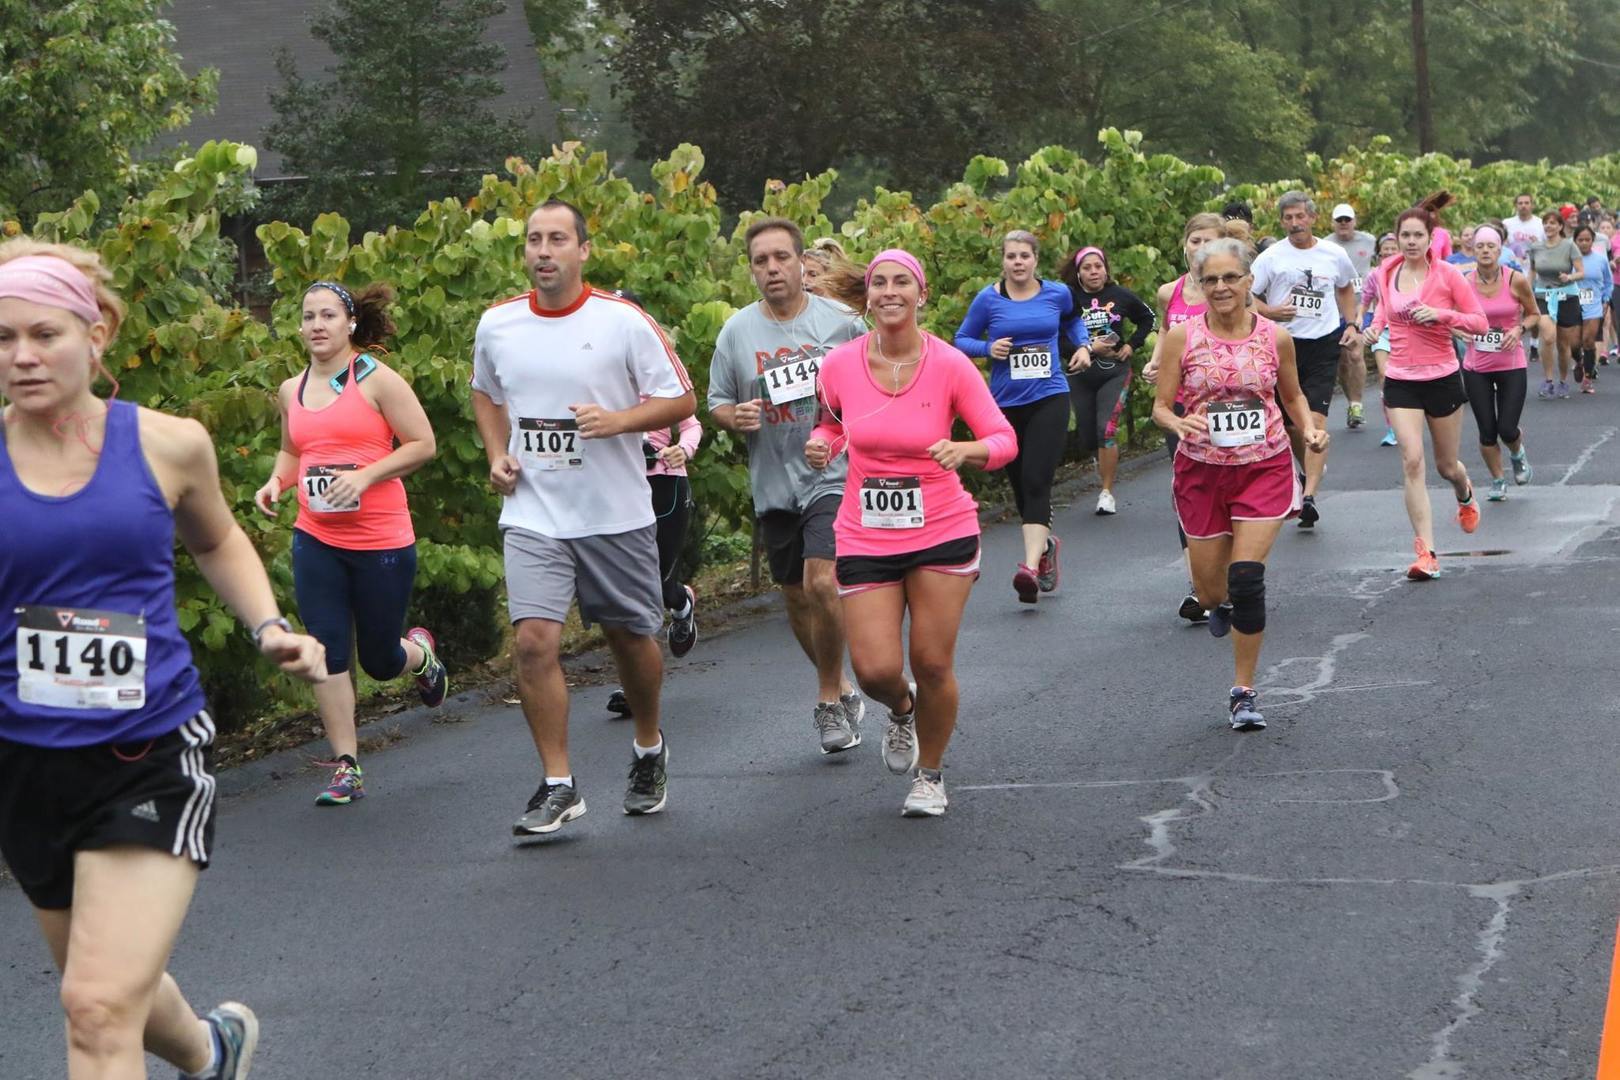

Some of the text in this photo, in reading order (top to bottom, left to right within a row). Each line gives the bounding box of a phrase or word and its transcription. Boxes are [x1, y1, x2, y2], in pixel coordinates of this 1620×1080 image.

[1292, 296, 1322, 310] 1130
[1013, 353, 1048, 368] 1008
[770, 359, 820, 389] 1144
[764, 400, 796, 425] 5K
[1213, 411, 1261, 432] 1102
[524, 431, 575, 453] 1107
[864, 490, 917, 511] 1001
[28, 633, 134, 677] 1140
